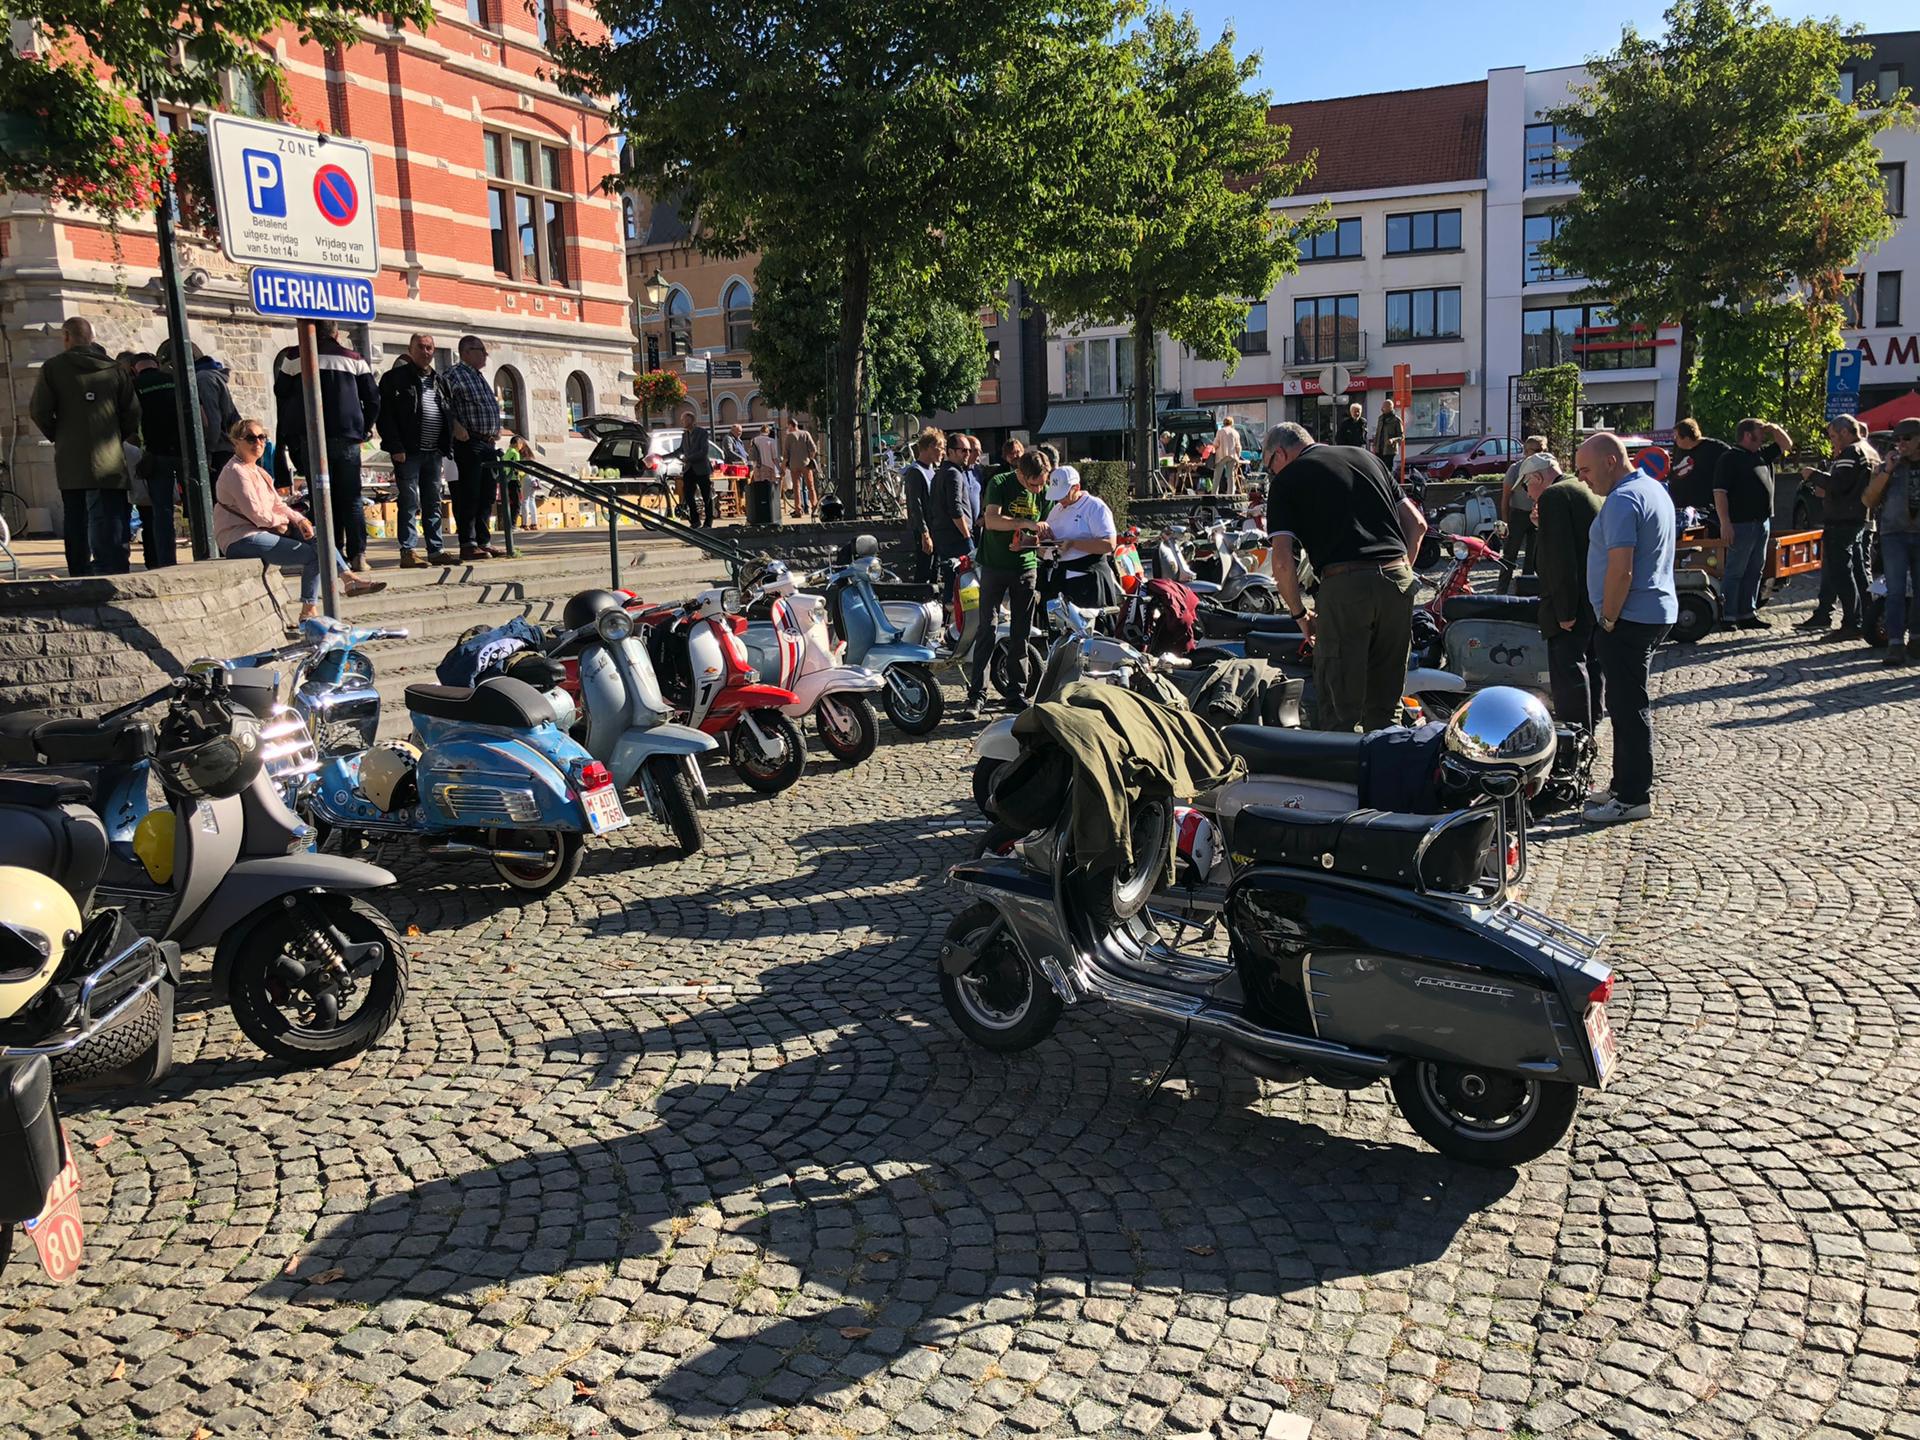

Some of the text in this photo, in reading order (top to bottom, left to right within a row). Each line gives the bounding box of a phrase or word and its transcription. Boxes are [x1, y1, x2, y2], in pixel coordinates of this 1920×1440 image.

[277, 138, 316, 158] ZONE
[247, 154, 278, 209] P
[252, 216, 288, 231] Betalend
[243, 229, 299, 247] uitgez. vrijdag
[315, 236, 364, 252] Vrijdag van
[247, 243, 261, 253] van
[263, 244, 269, 254] 5
[270, 245, 281, 255] tot
[322, 251, 328, 261] 5
[330, 252, 343, 262] tot
[258, 275, 371, 315] HERHALING
[1835, 352, 1855, 377] P
[700, 683, 713, 706] 1
[603, 807, 623, 825] 765
[47, 1219, 81, 1276] 80
